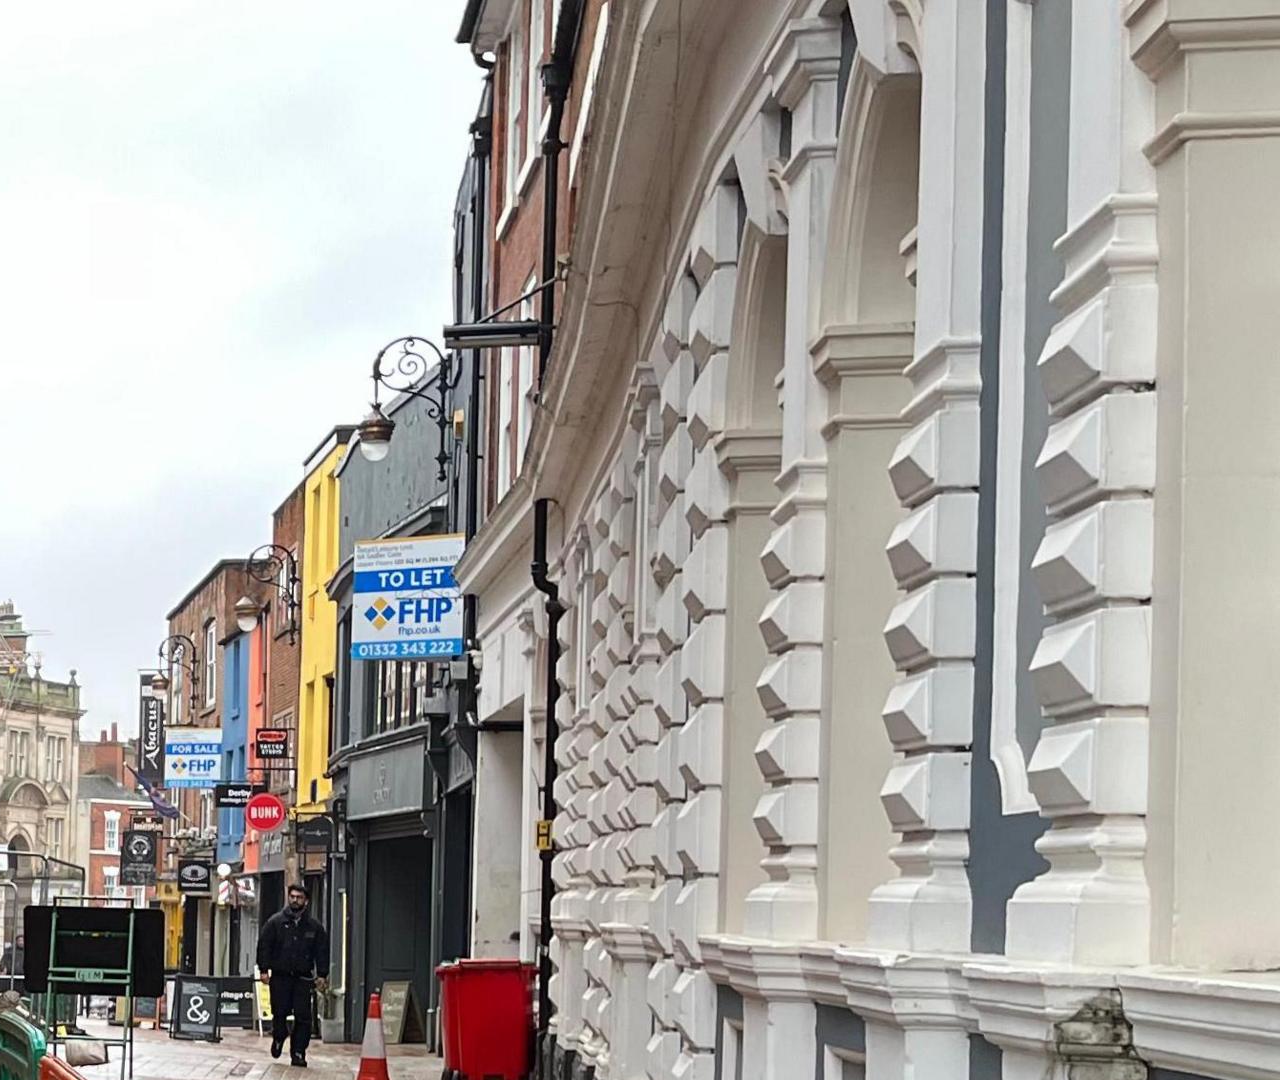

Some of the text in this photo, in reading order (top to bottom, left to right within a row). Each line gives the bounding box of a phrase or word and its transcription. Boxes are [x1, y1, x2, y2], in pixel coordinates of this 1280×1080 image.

[378, 569, 444, 588] TO LET
[398, 598, 452, 624] FHP
[398, 626, 441, 635] fhp.co.uk
[360, 641, 454, 656] 01332 343 222
[144, 700, 160, 770] Abacus
[172, 744, 218, 753] FOR SALE
[188, 760, 216, 772] FHP
[228, 789, 251, 798] Derby
[250, 806, 279, 819] BUNK
